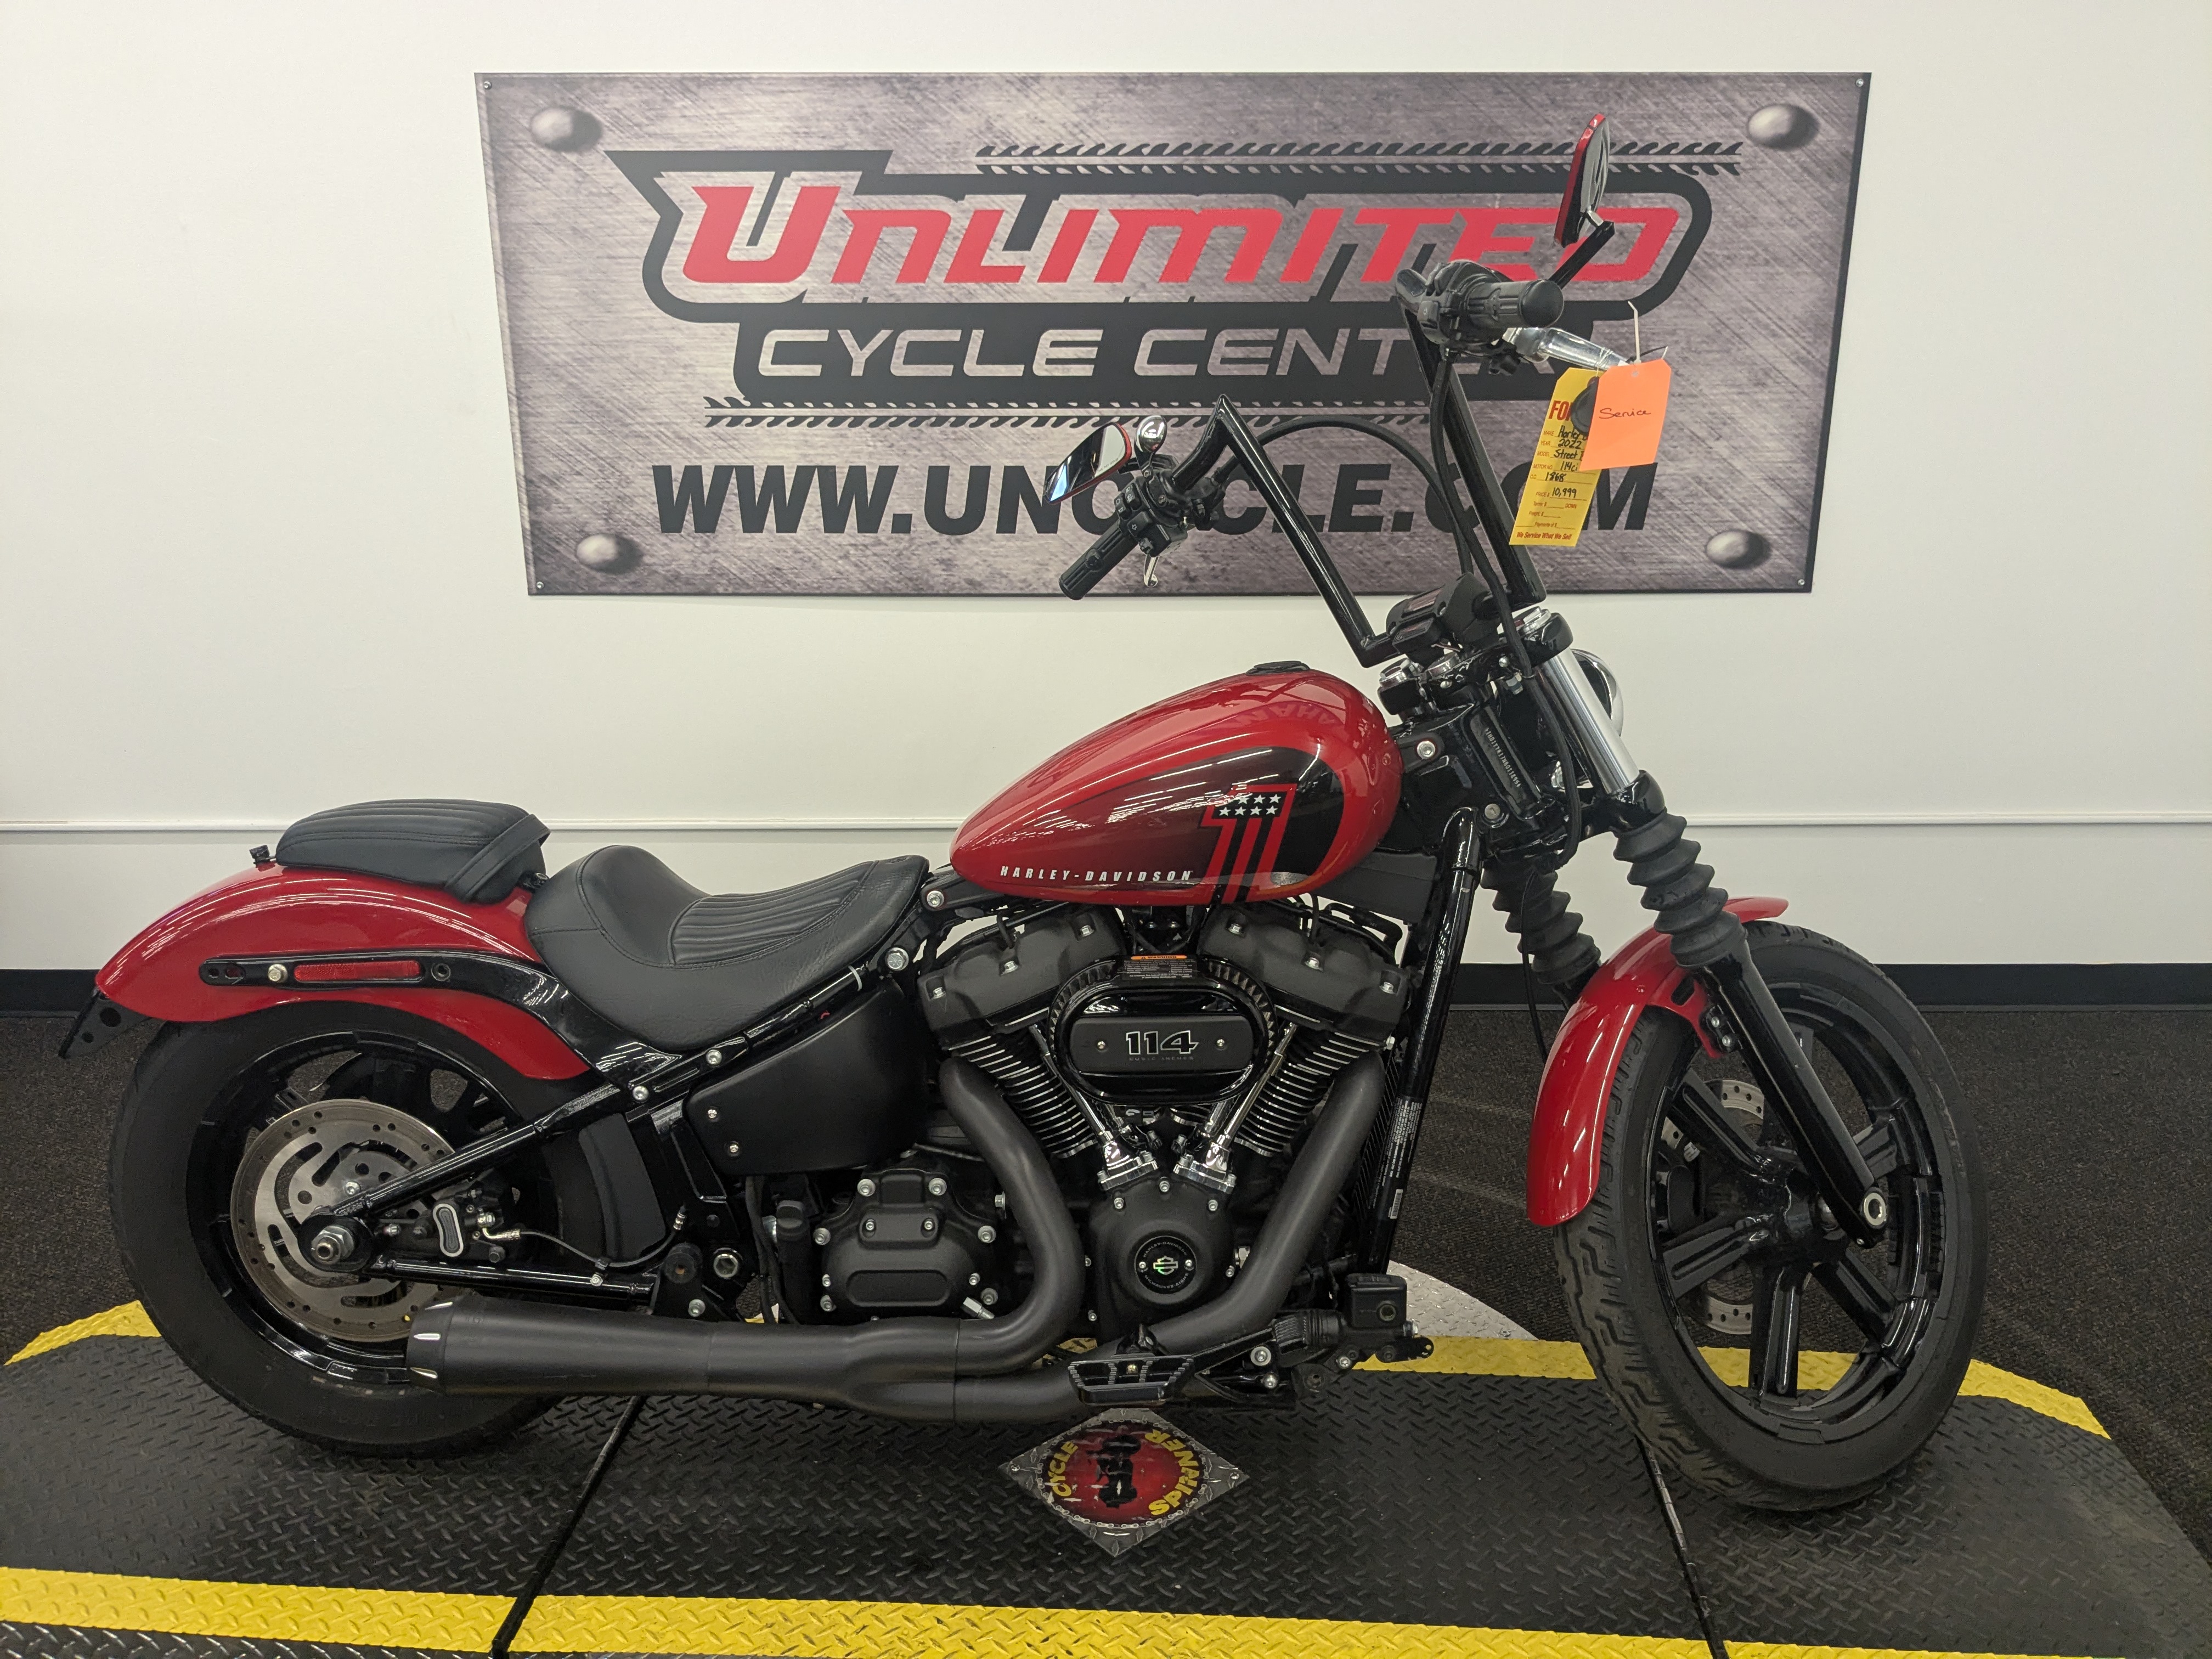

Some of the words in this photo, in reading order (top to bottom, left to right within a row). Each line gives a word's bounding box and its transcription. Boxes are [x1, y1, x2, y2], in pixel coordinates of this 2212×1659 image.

[683, 186, 1679, 283] UNLIMITED
[758, 330, 1103, 377] CYCLE
[1133, 329, 1555, 376] CENT
[1599, 408, 1651, 419] Service
[1558, 438, 1582, 449] 2022
[1553, 448, 1578, 459] Street
[1545, 471, 1567, 482] 1868
[1551, 487, 1577, 498] 10,999
[1000, 866, 1192, 882] HARLEY-DAVIDSON
[1125, 1030, 1199, 1055] 114
[1048, 1441, 1079, 1497] CYCLE
[1144, 1429, 1200, 1516] SPINNER
